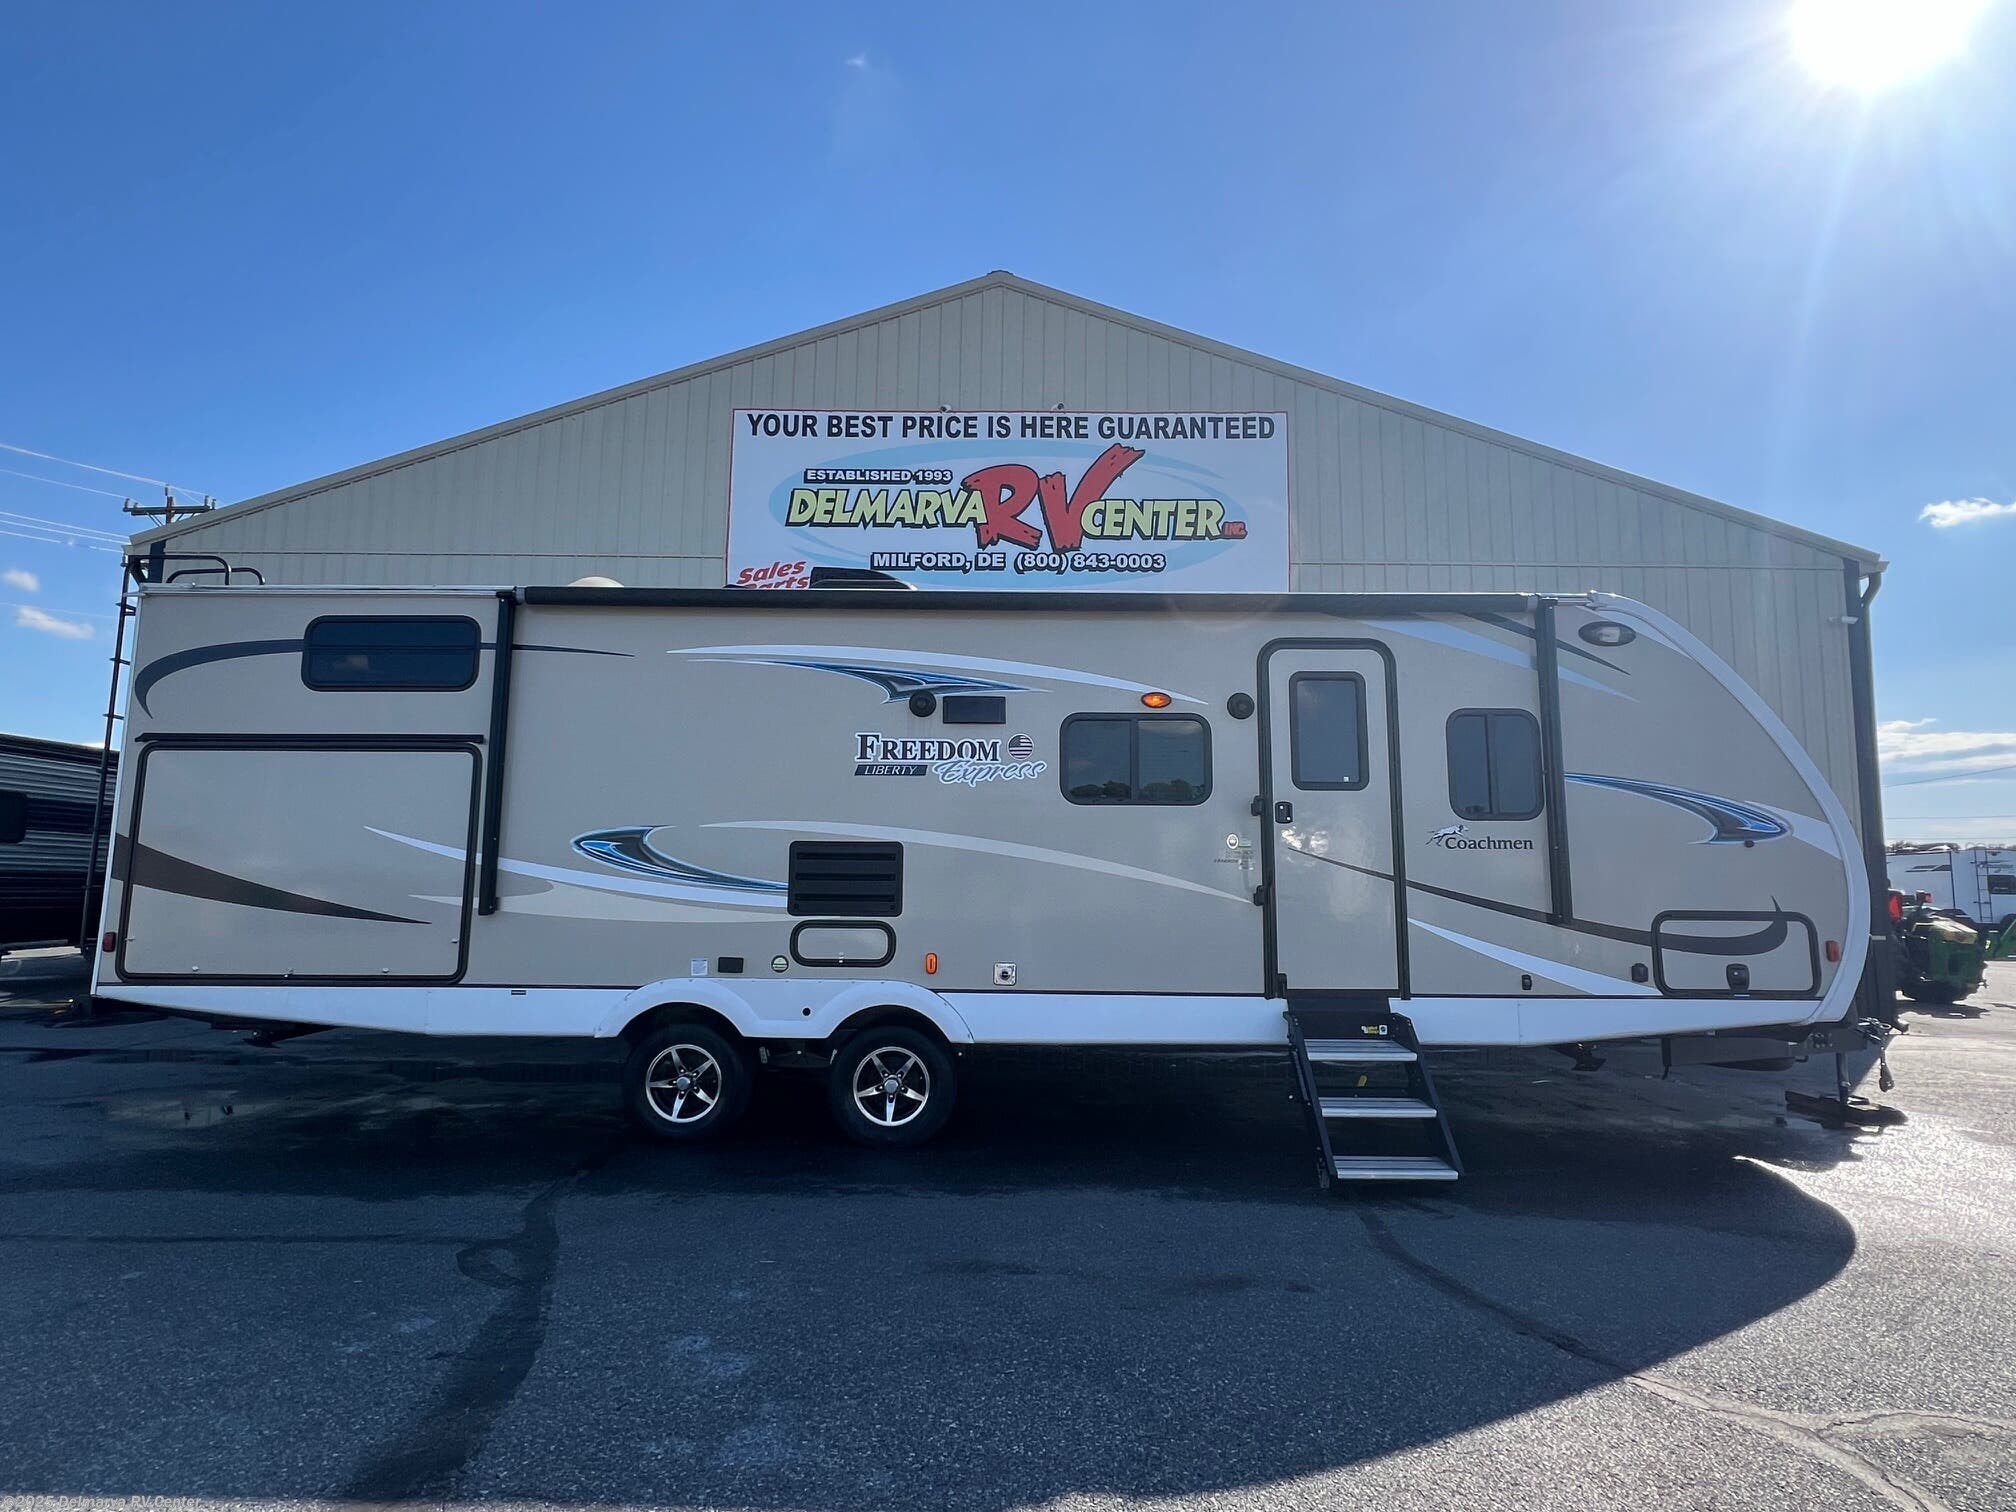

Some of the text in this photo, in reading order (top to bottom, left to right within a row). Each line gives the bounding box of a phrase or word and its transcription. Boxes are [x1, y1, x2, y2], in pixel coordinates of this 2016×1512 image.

[748, 414, 1275, 440] YOUR BEST PRICE IS HERE GUARANTEED
[805, 469, 953, 483] ESTABLISHED 1993
[785, 488, 989, 528] DELMARVA
[961, 443, 1146, 551] RV
[1081, 498, 1225, 540] CENTER
[737, 561, 806, 584] Sales
[871, 552, 1166, 574] MILFORD, DE (800) 843-0003
[855, 734, 1000, 762] FREEDOM
[863, 760, 1047, 786] LIBERTY Express
[1445, 836, 1534, 850] Coachmen
